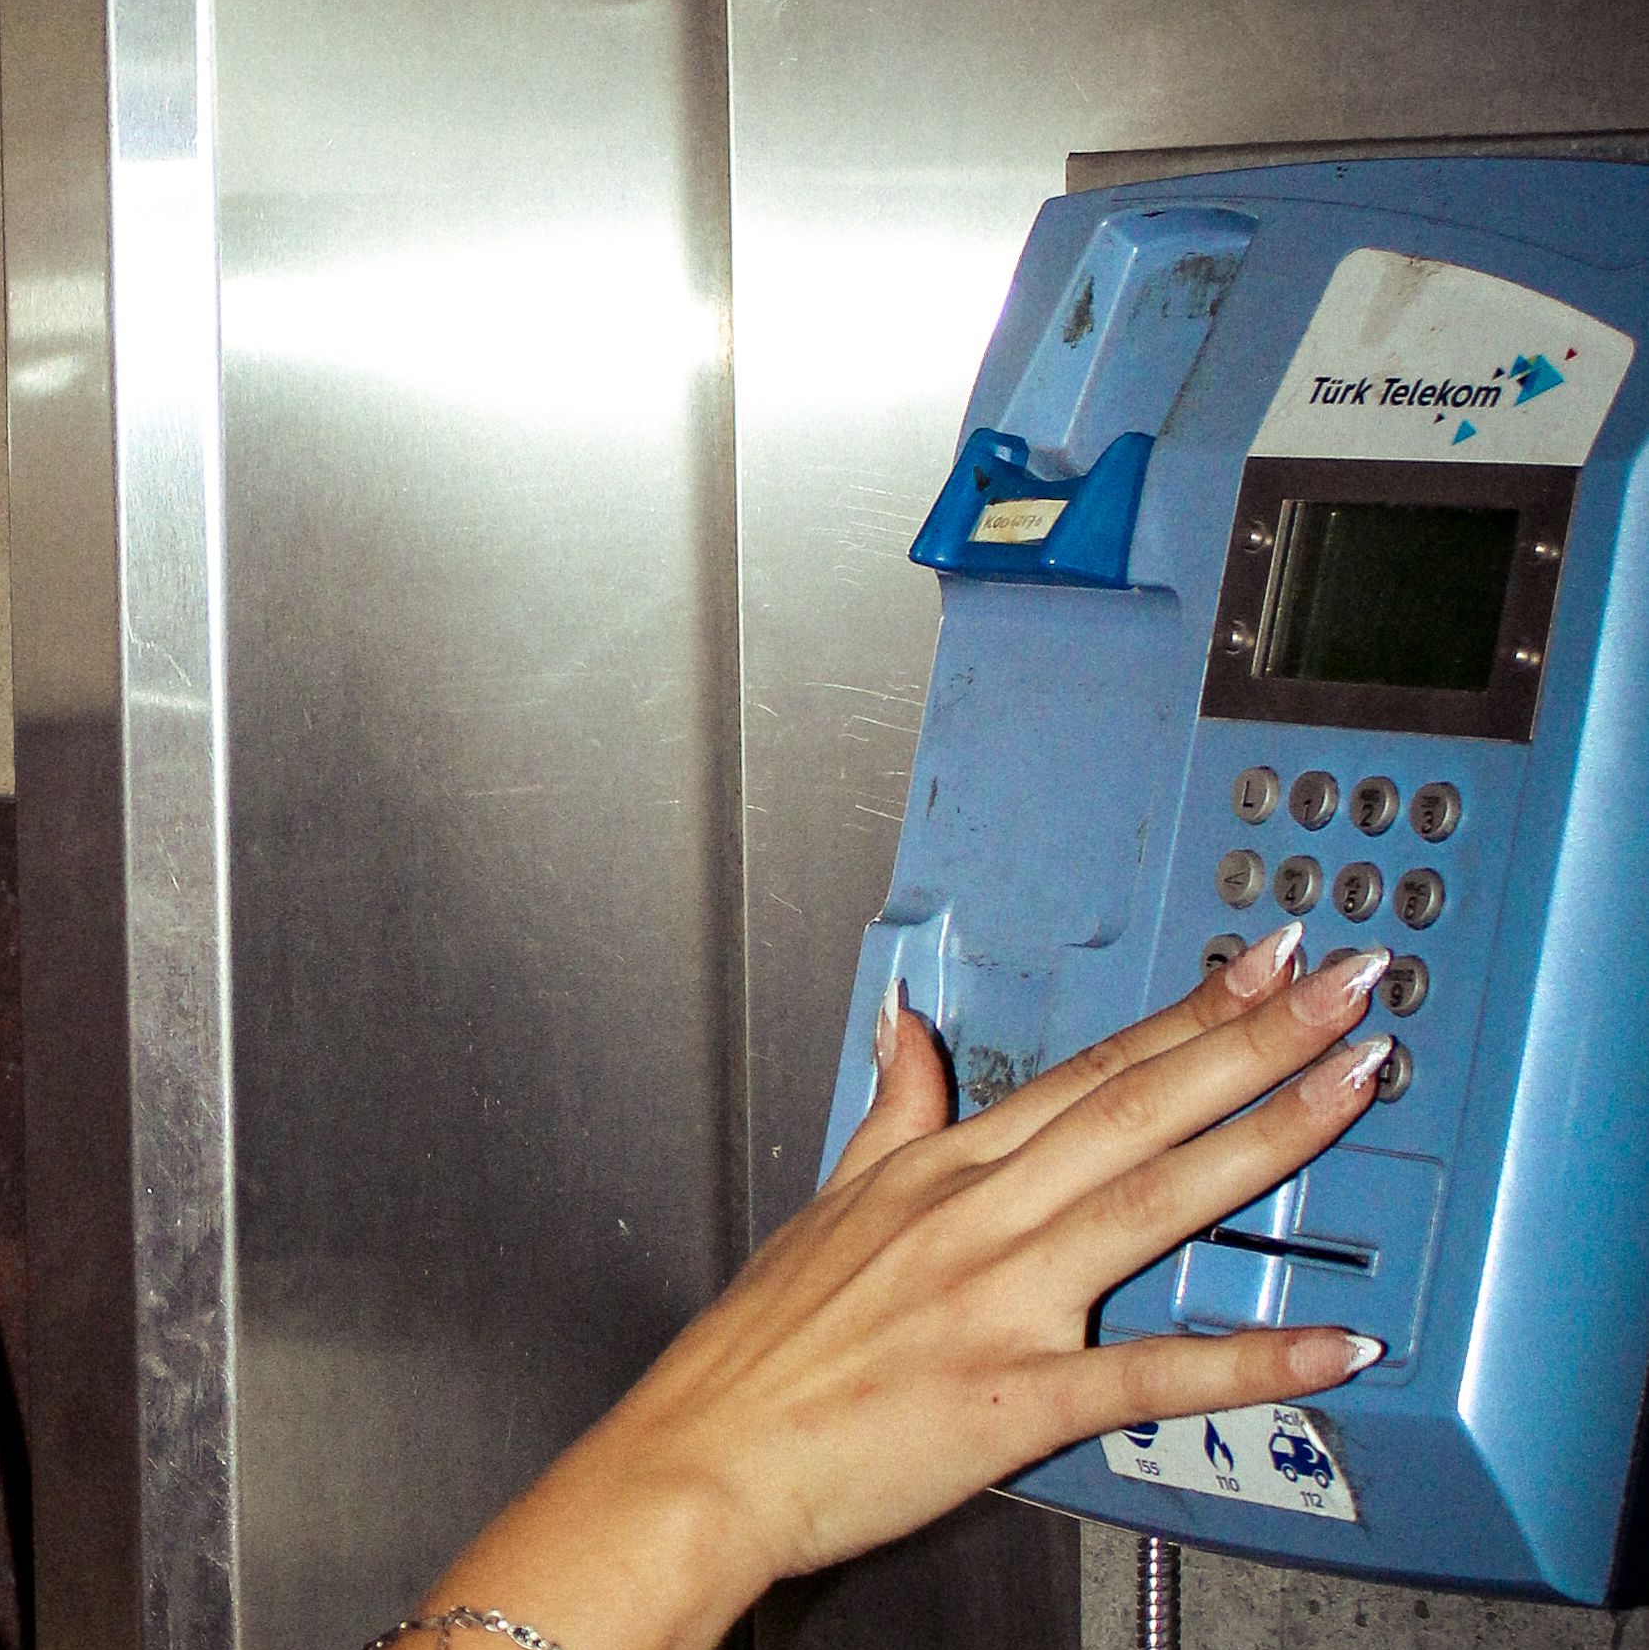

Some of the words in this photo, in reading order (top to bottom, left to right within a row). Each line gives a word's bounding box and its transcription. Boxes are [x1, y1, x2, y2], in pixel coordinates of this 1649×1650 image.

[1308, 377, 1374, 405] Türk
[1378, 378, 1502, 409] Telekom
[1359, 802, 1375, 828] 2
[1421, 810, 1434, 834] 3
[1284, 882, 1297, 903] 4
[1344, 890, 1357, 914] 5
[1389, 983, 1404, 1007] 9
[1136, 1458, 1160, 1476] 155
[1216, 1475, 1239, 1492] 110
[1301, 1491, 1324, 1509] 112
